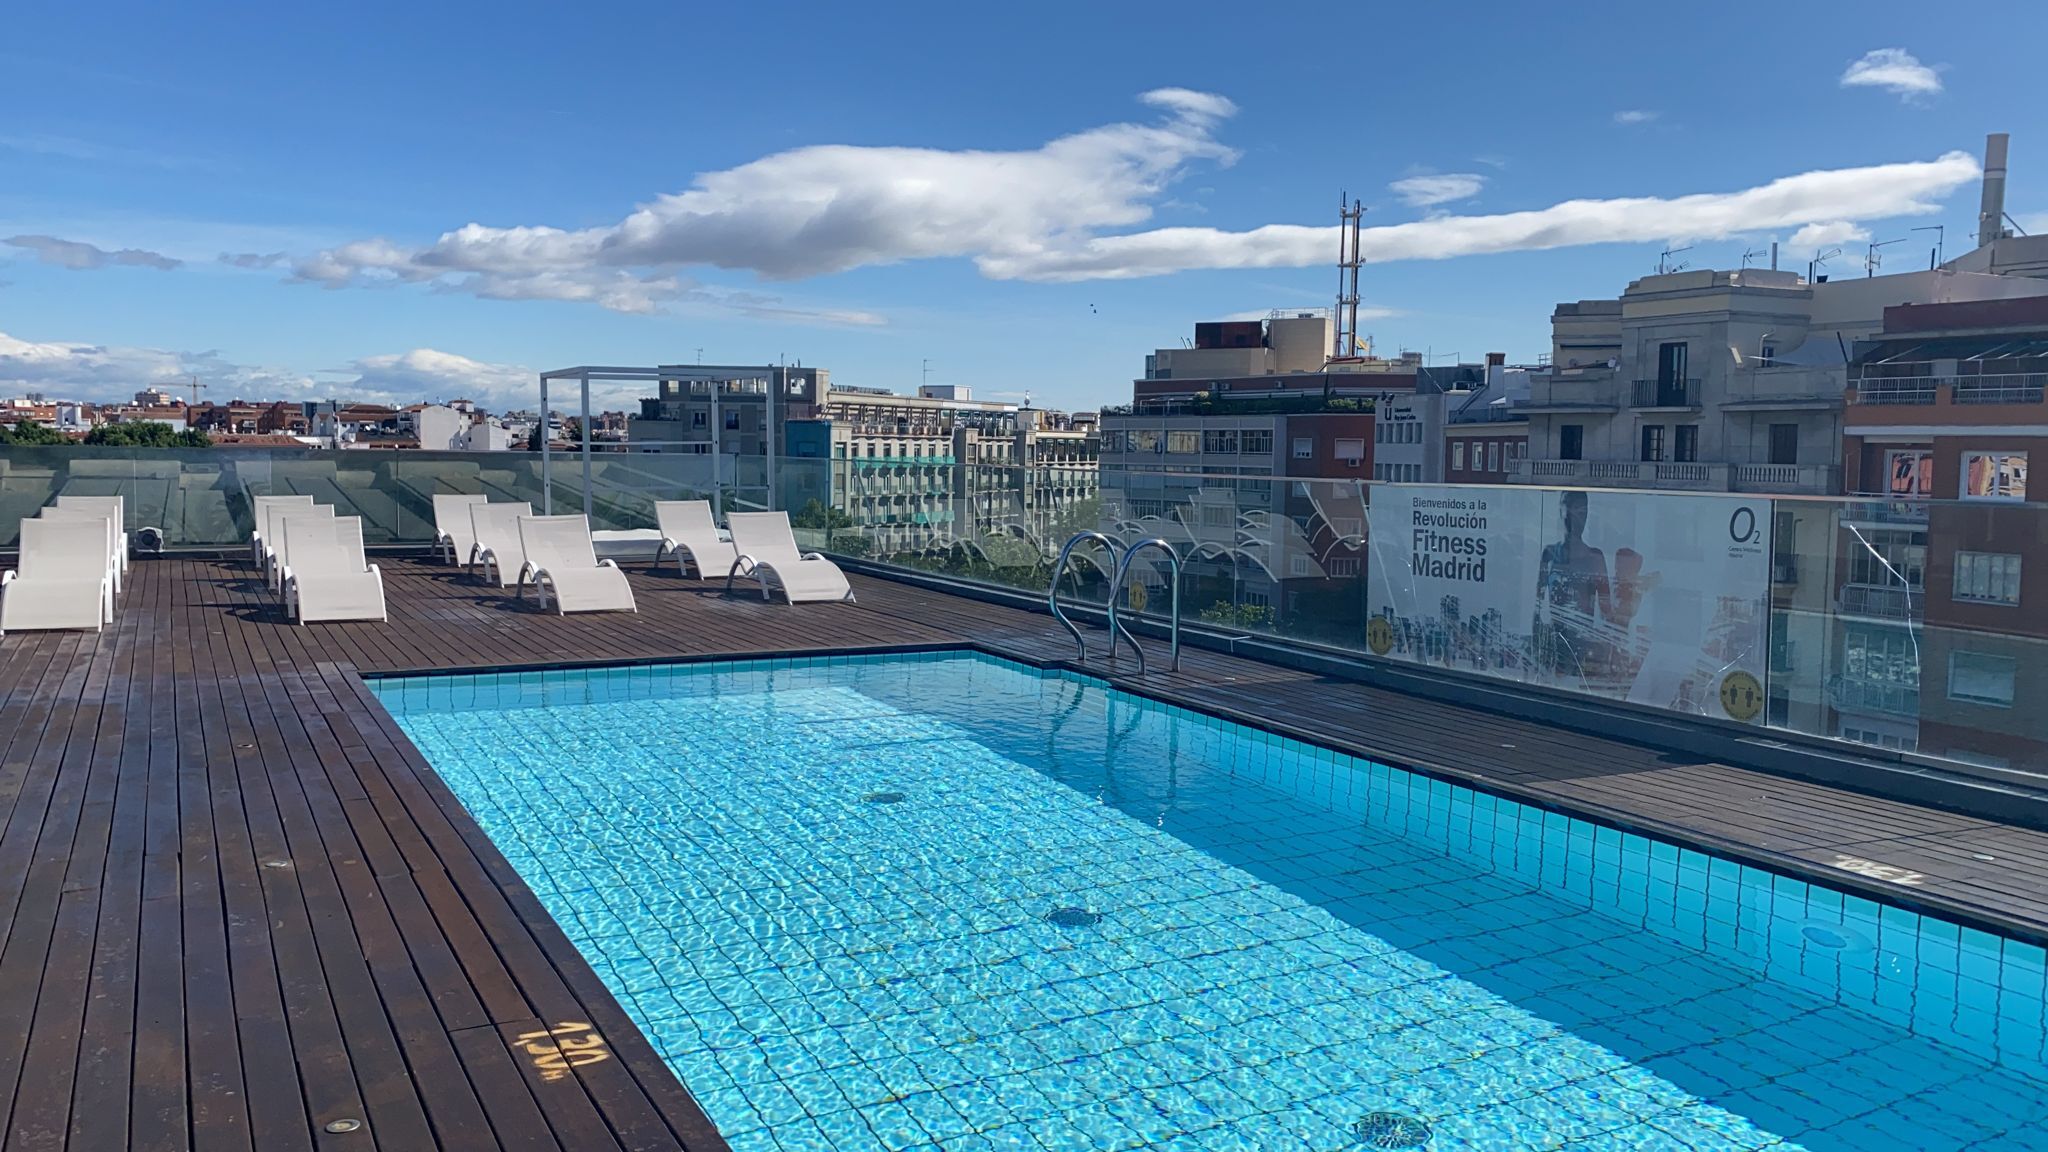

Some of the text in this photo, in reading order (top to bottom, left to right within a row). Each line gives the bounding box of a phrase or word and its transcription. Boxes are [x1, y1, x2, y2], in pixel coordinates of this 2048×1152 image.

[1412, 497, 1487, 511] Bienvenidos a la
[1412, 510, 1487, 530] Revolución
[1412, 529, 1487, 556] Fitness
[1412, 552, 1486, 583] Madrid
